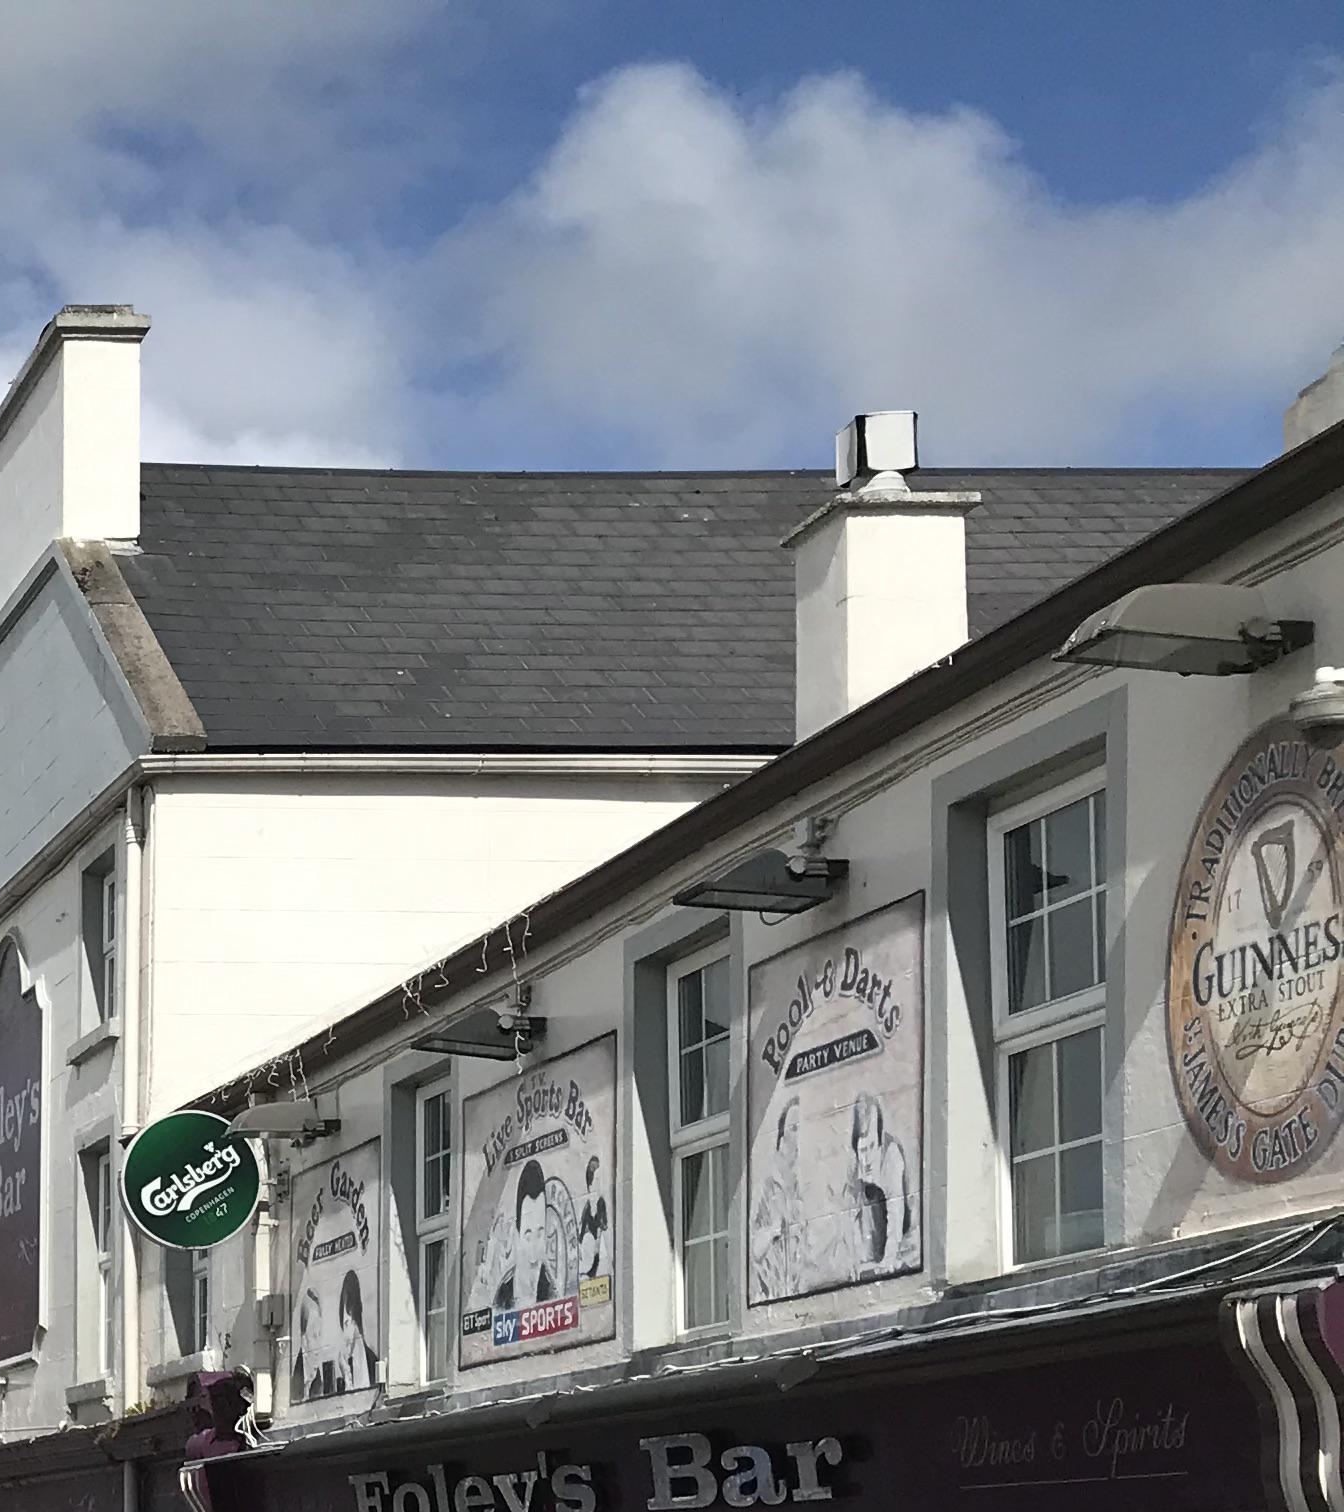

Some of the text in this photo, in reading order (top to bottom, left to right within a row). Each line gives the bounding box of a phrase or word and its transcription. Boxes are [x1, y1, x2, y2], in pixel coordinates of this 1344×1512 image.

[1192, 912, 1344, 1007] GUINNES
[1217, 970, 1326, 1022] EXTRA STOUT
[761, 974, 810, 1075] Pool
[840, 947, 900, 1033] Darts
[796, 1033, 869, 1073] PARTY VENUE
[482, 1079, 593, 1177] Live Sports Bar
[1251, 1104, 1319, 1173] GATE
[140, 1144, 241, 1216] Carlsberg
[184, 1186, 235, 1223] COPENHAGEN
[296, 1160, 371, 1268] Beer Garden
[495, 1302, 574, 1342] sky SPORTS
[638, 1432, 843, 1512] Bar
[951, 1415, 1037, 1468] Wines
[1082, 1396, 1190, 1479] Spirits
